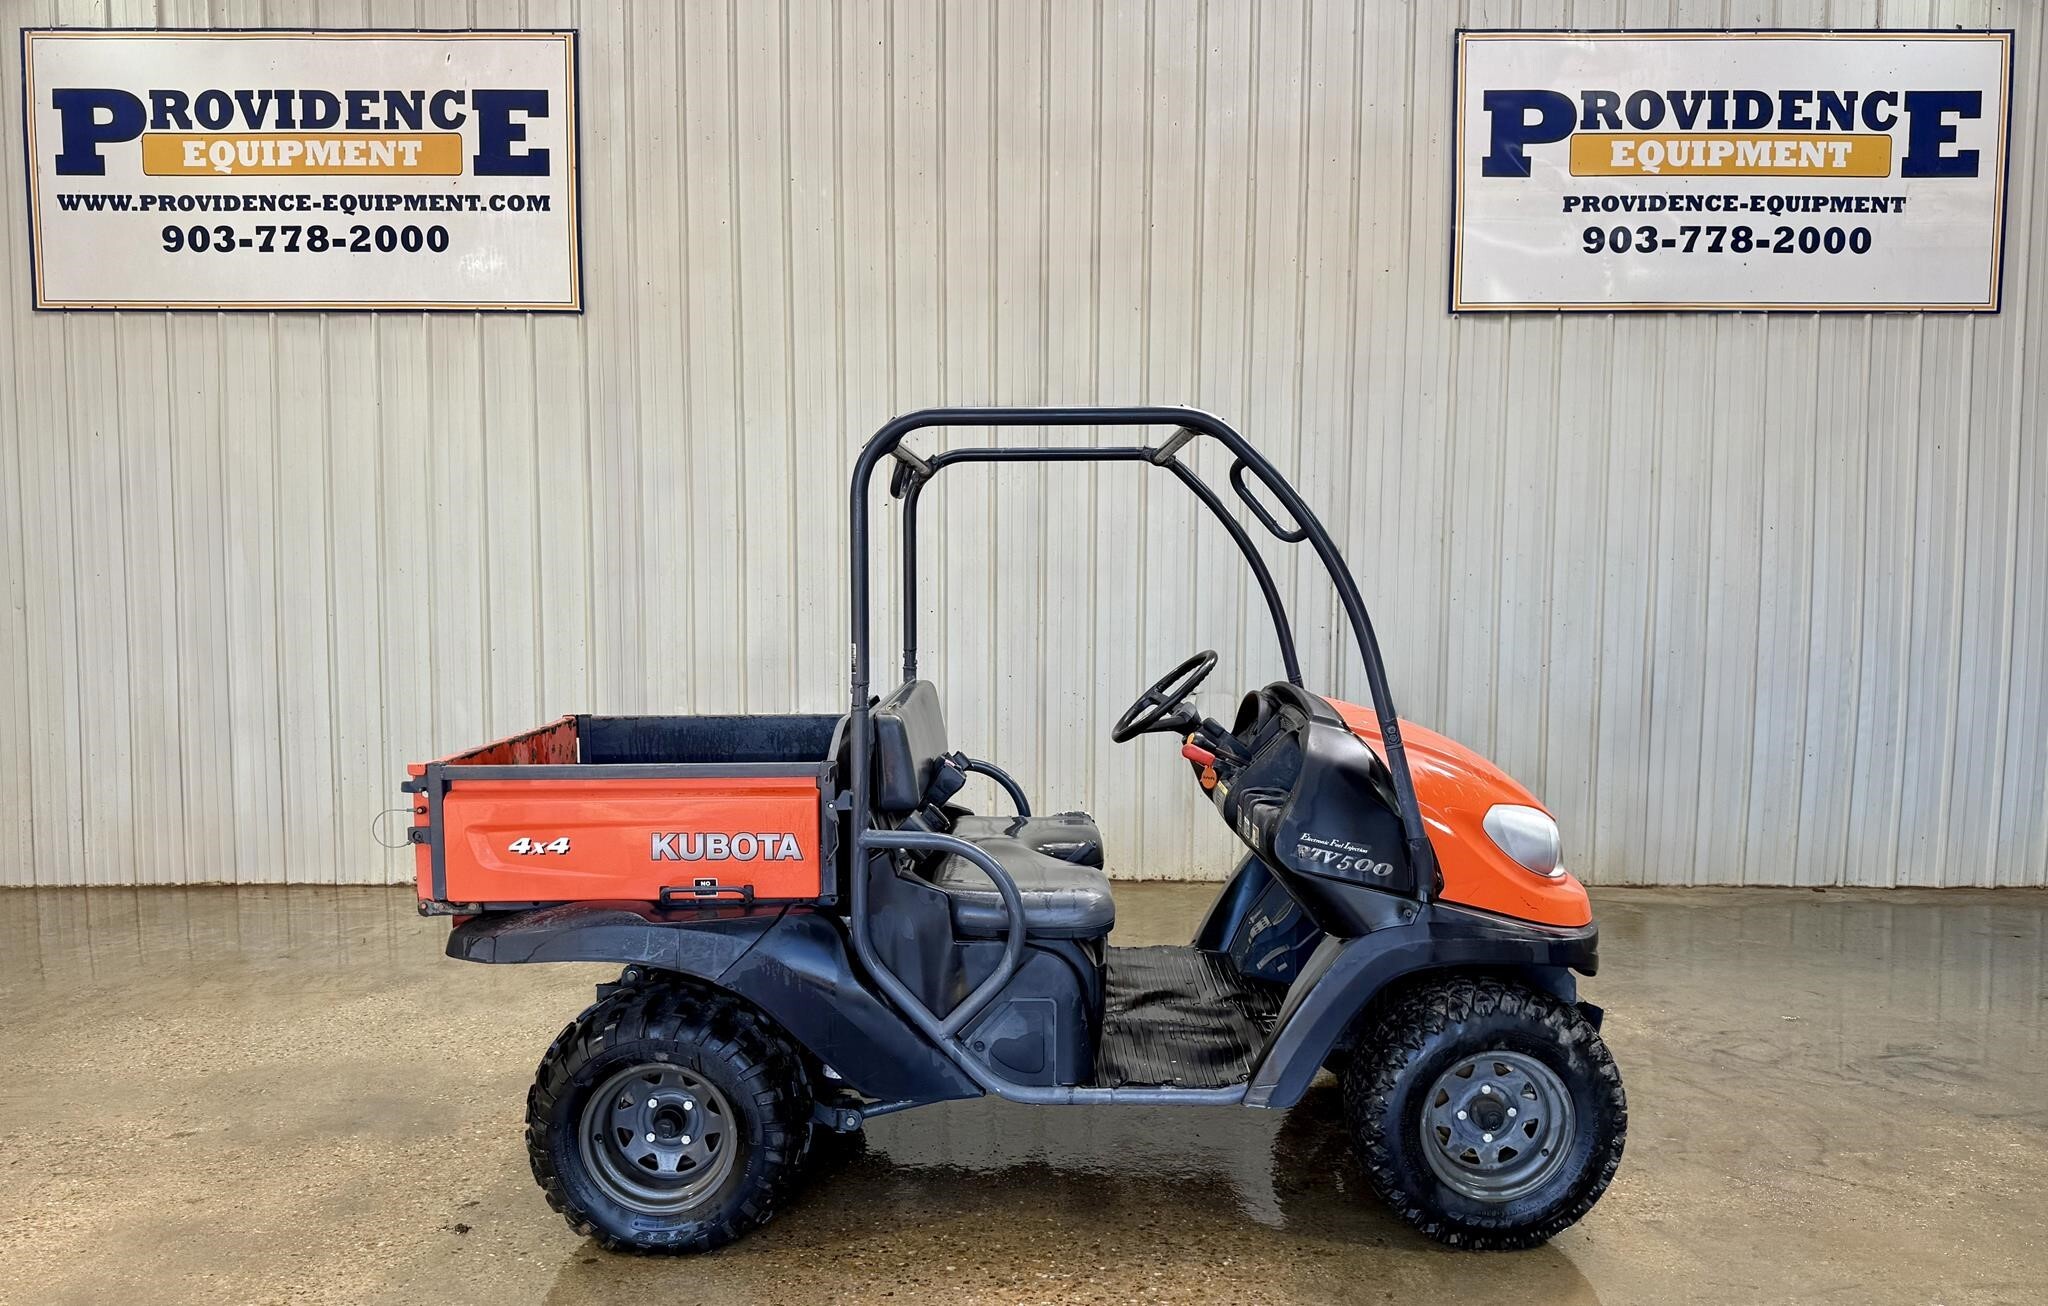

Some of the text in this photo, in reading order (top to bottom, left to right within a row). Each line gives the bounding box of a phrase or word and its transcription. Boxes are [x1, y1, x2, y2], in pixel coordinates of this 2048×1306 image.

[51, 88, 551, 176] PROVIDENCE
[1481, 89, 1983, 178] PROVIDENCE
[183, 139, 422, 173] EQUIPMENT
[1610, 140, 1853, 173] EQUIPMENT
[56, 194, 551, 213] WWW.PROVIDENCE-EQUIPMENT.COM
[1562, 194, 1907, 214] PROVIDENCE-EQUIPMENT
[161, 224, 450, 253] 903-778-2000
[1582, 225, 1872, 254] 903-778-2000
[508, 837, 571, 856] 4x4
[650, 832, 804, 861] KUBOTA
